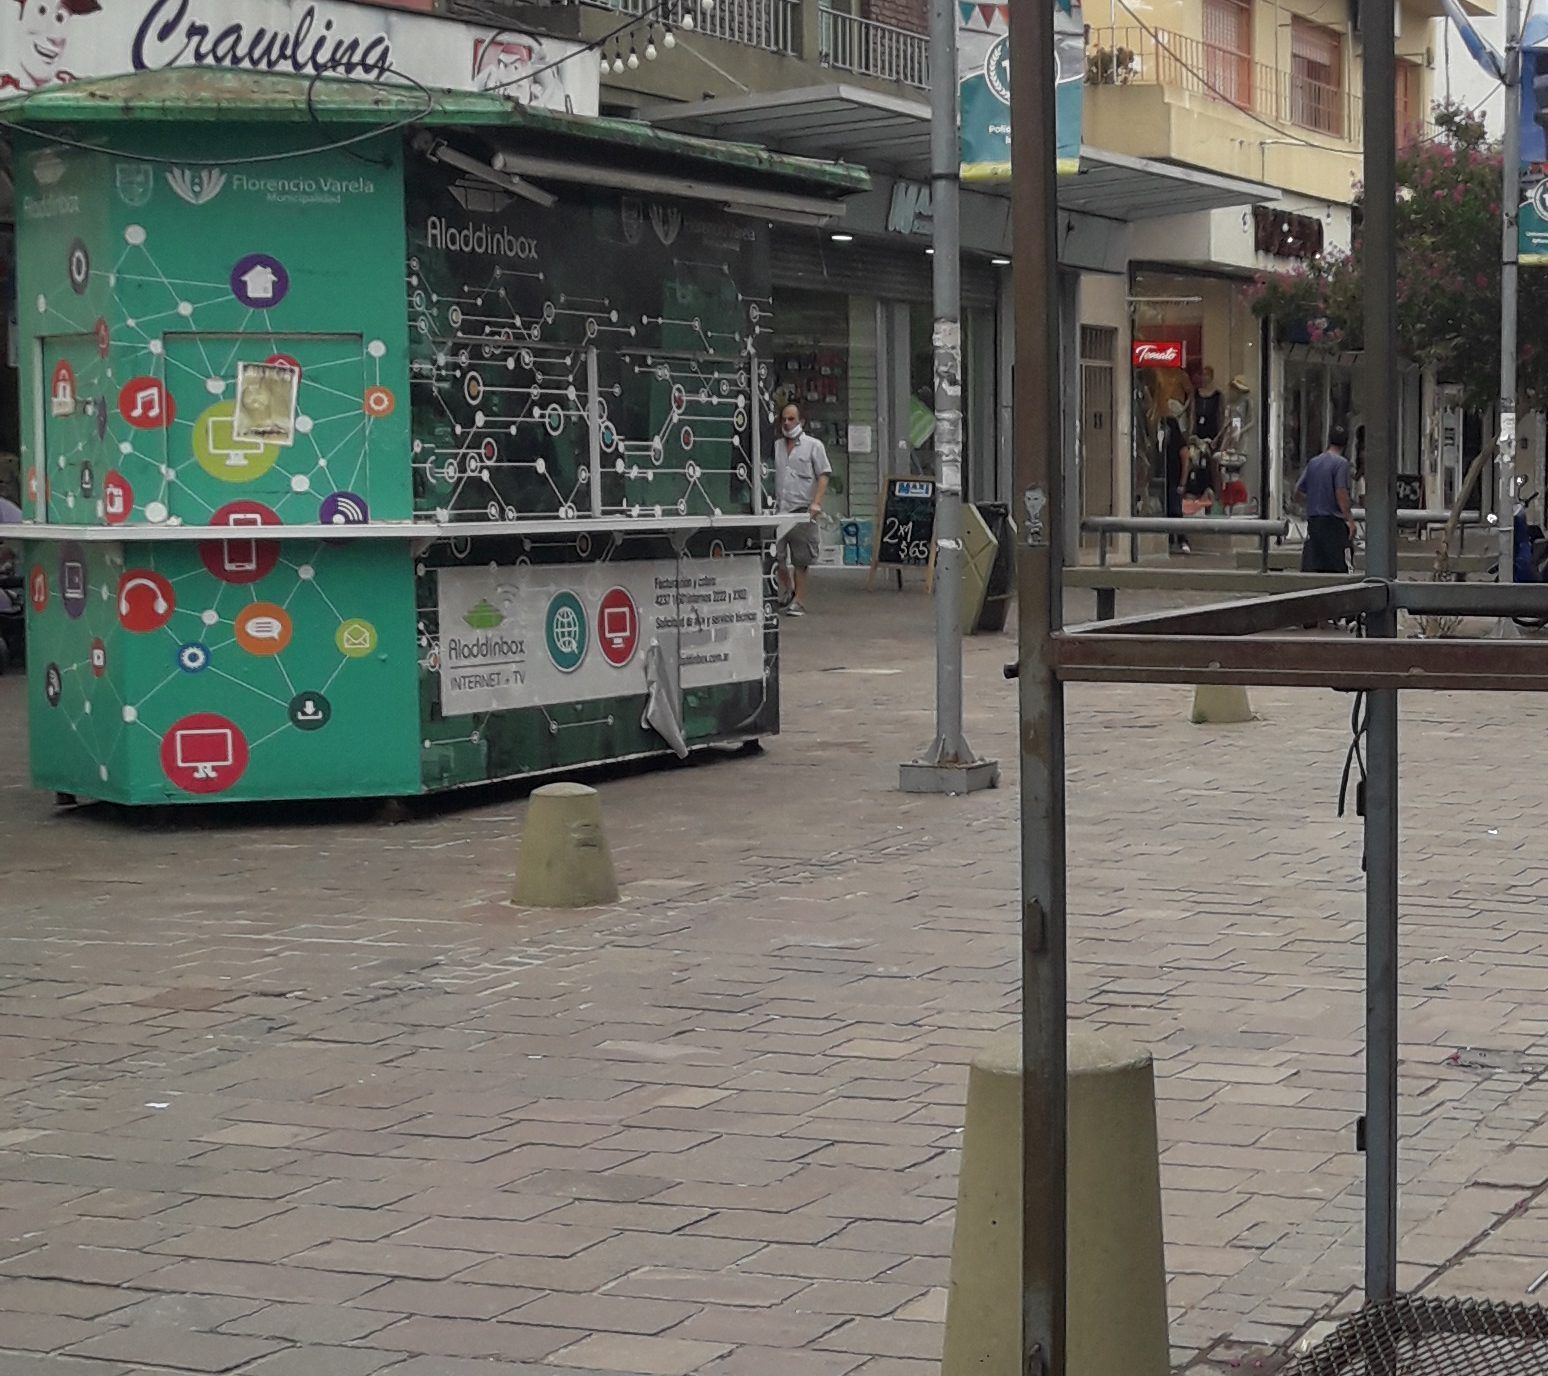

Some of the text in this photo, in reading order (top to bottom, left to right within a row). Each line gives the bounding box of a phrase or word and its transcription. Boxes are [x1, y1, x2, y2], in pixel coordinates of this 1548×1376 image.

[232, 175, 375, 194] Florencio Varela
[427, 215, 538, 260] Aladdinbox
[448, 632, 526, 662] Aladdinbox
[450, 672, 501, 692] INTERNET
[513, 670, 527, 687] TV
